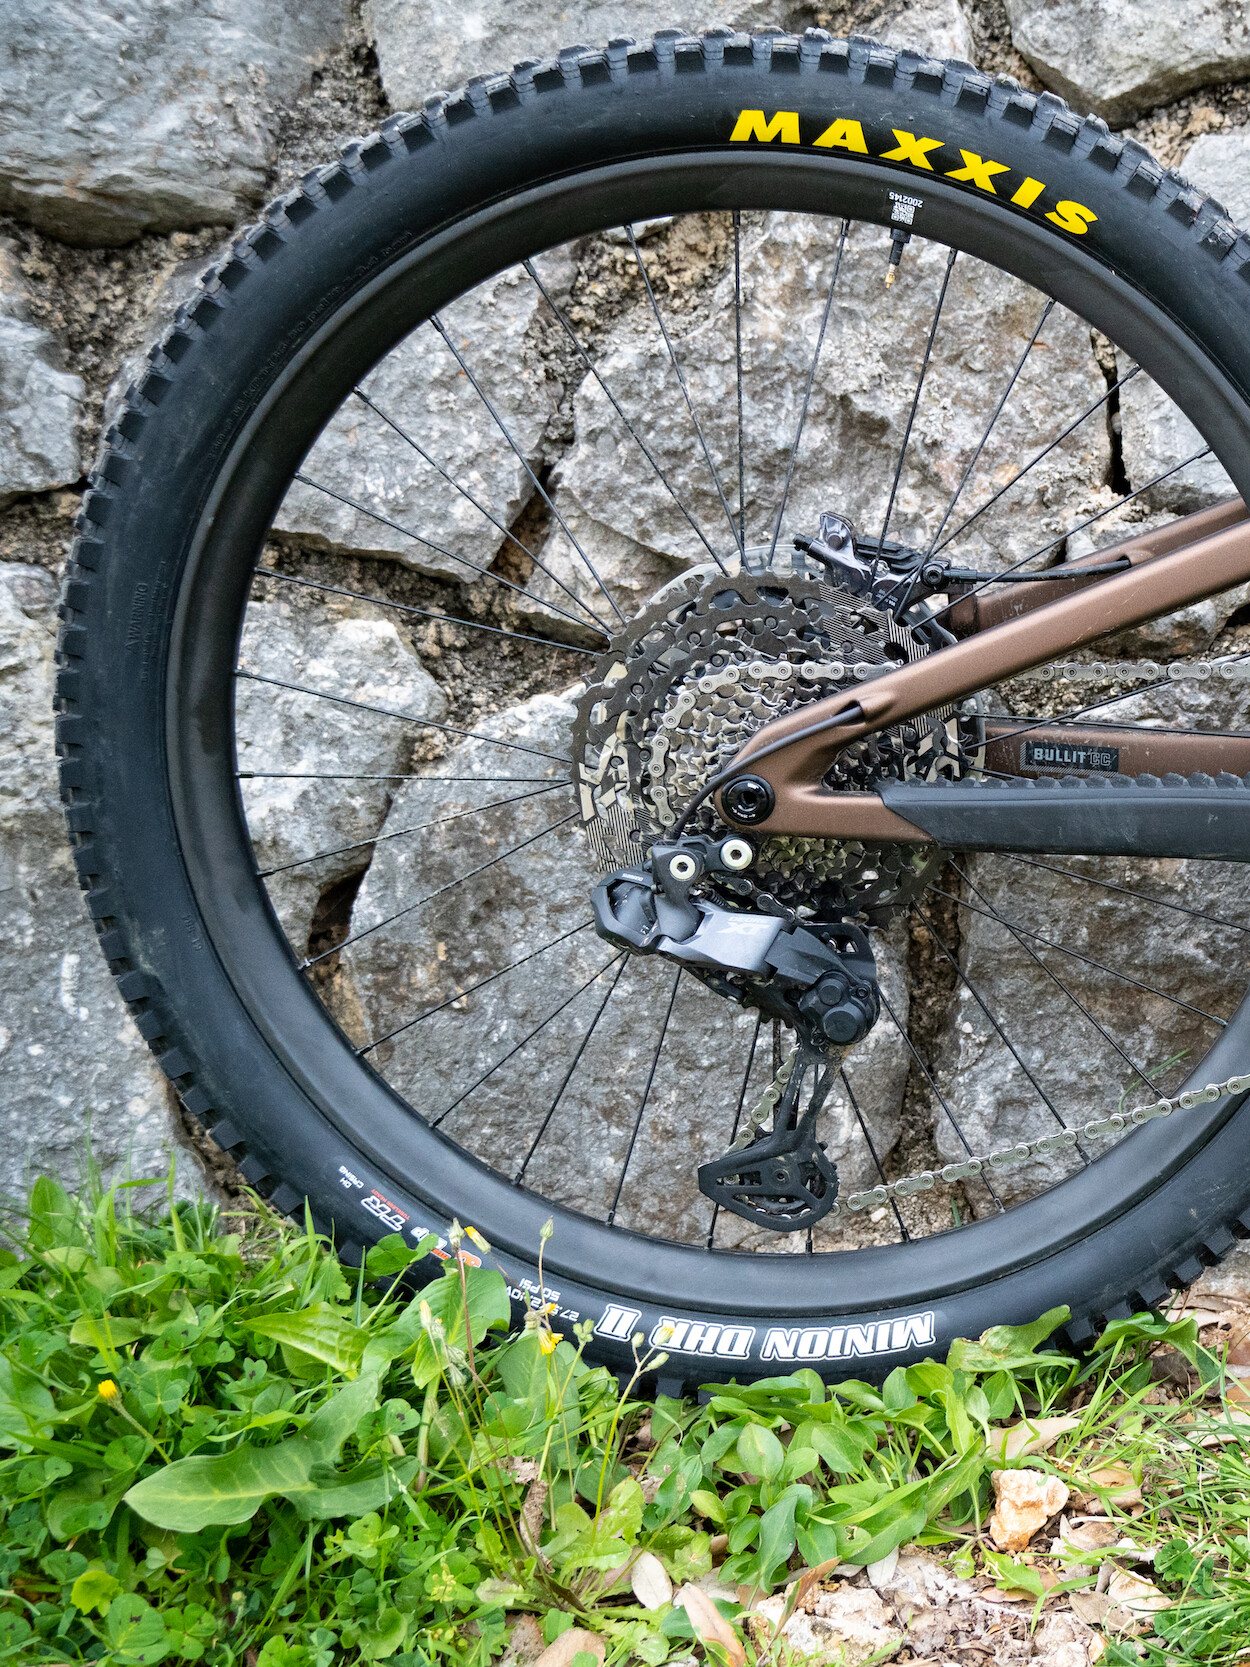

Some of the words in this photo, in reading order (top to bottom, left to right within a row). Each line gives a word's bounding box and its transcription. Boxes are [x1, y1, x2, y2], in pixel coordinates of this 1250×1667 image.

[729, 109, 1098, 235] MAXXIS
[889, 191, 924, 209] 2002145
[1034, 747, 1086, 764] BULLIT
[1089, 752, 1111, 767] CC
[715, 922, 771, 935] XT
[338, 1165, 365, 1189] CASING
[360, 1195, 406, 1231] TR
[519, 1278, 541, 1293] PSI
[594, 1303, 642, 1342] II
[759, 1310, 936, 1362] MINION
[650, 1317, 757, 1361] DHR
